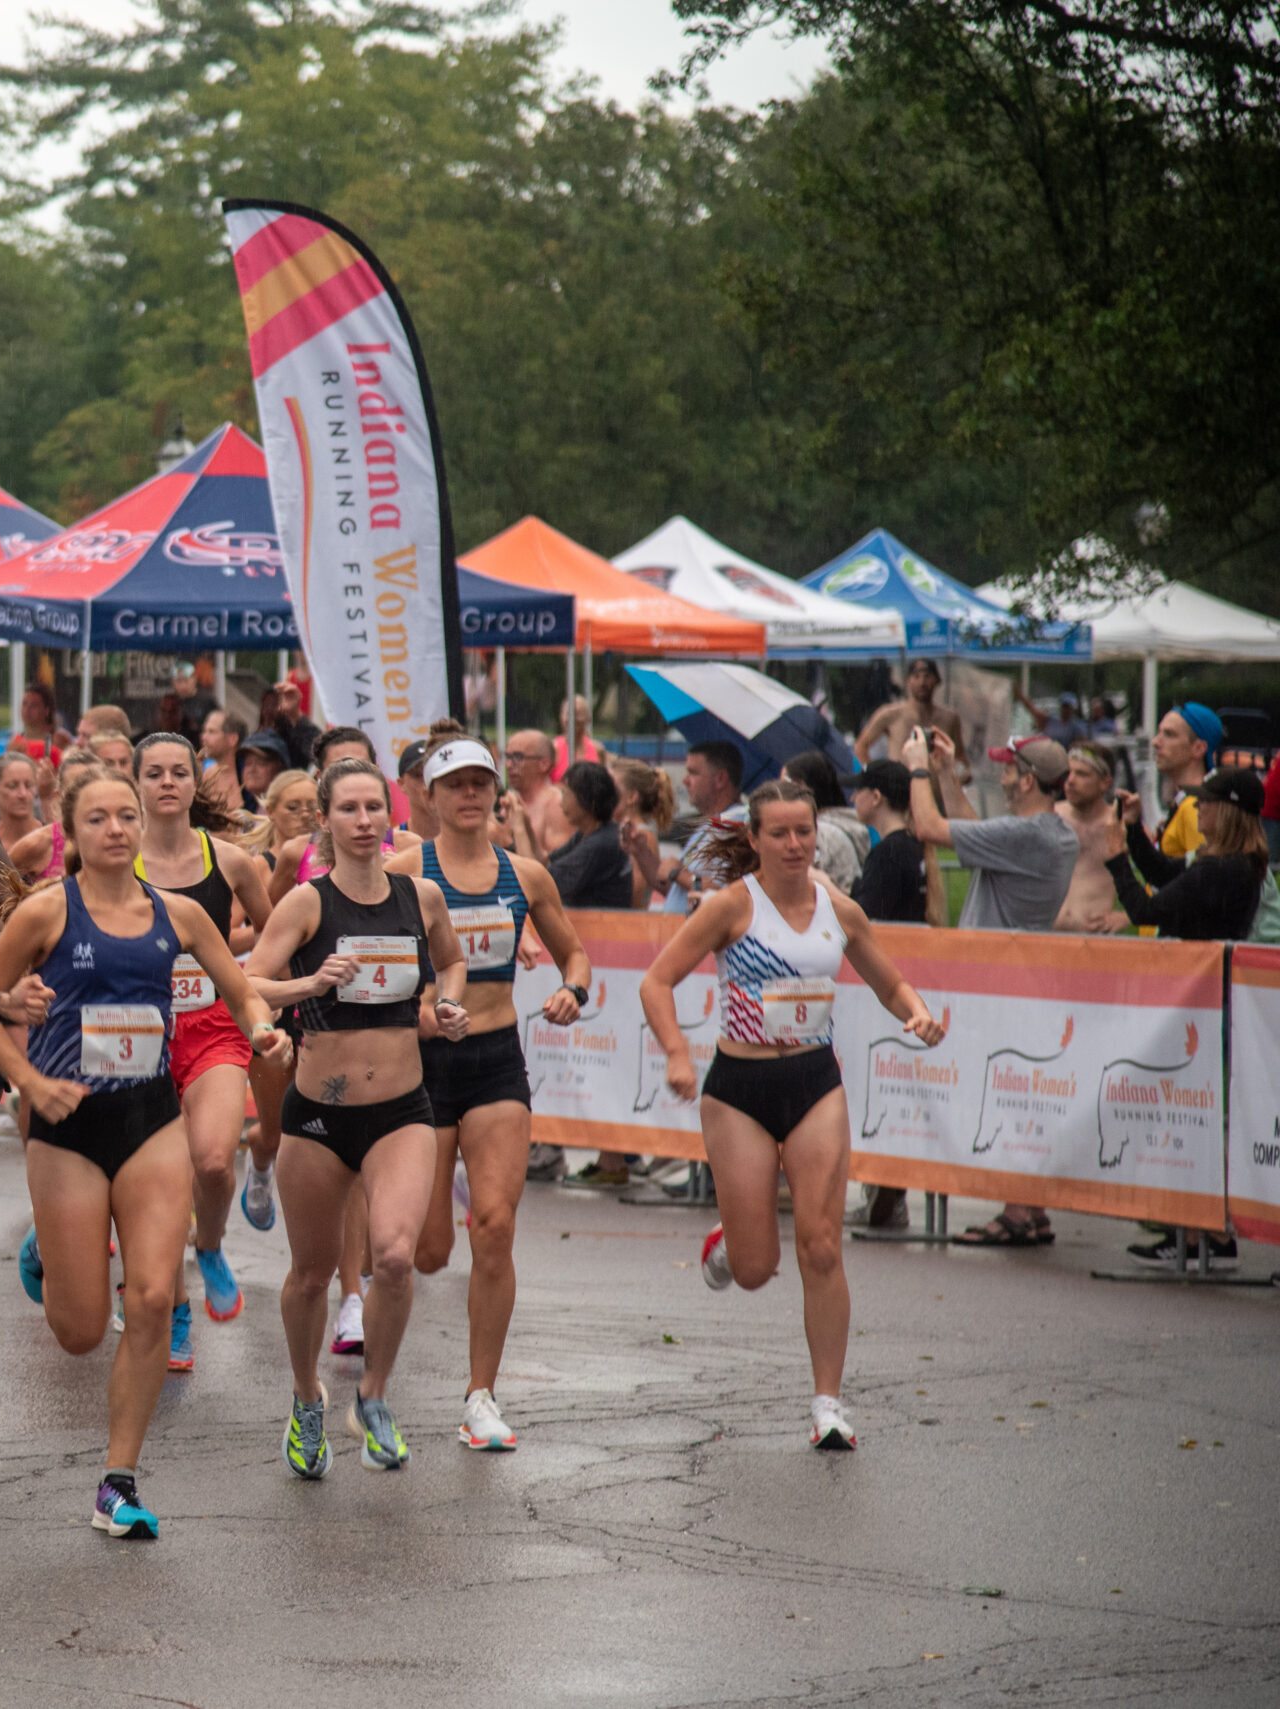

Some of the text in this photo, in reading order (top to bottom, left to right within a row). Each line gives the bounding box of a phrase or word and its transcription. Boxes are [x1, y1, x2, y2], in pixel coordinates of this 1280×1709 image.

[321, 371, 375, 729] RUNNING FESTIVAL
[346, 342, 430, 759] Indiana Women's
[36, 604, 79, 634] Group
[112, 609, 228, 637] Carmel
[461, 606, 557, 637] Group
[466, 931, 490, 955] 14
[373, 965, 387, 988] 4
[795, 1002, 807, 1025] 8
[119, 1035, 132, 1060] 3
[992, 1064, 1077, 1097] Indiana Women's
[1106, 1076, 1215, 1110] Indiana Women's
[1114, 1108, 1209, 1128] RUNNING FESTIVAL
